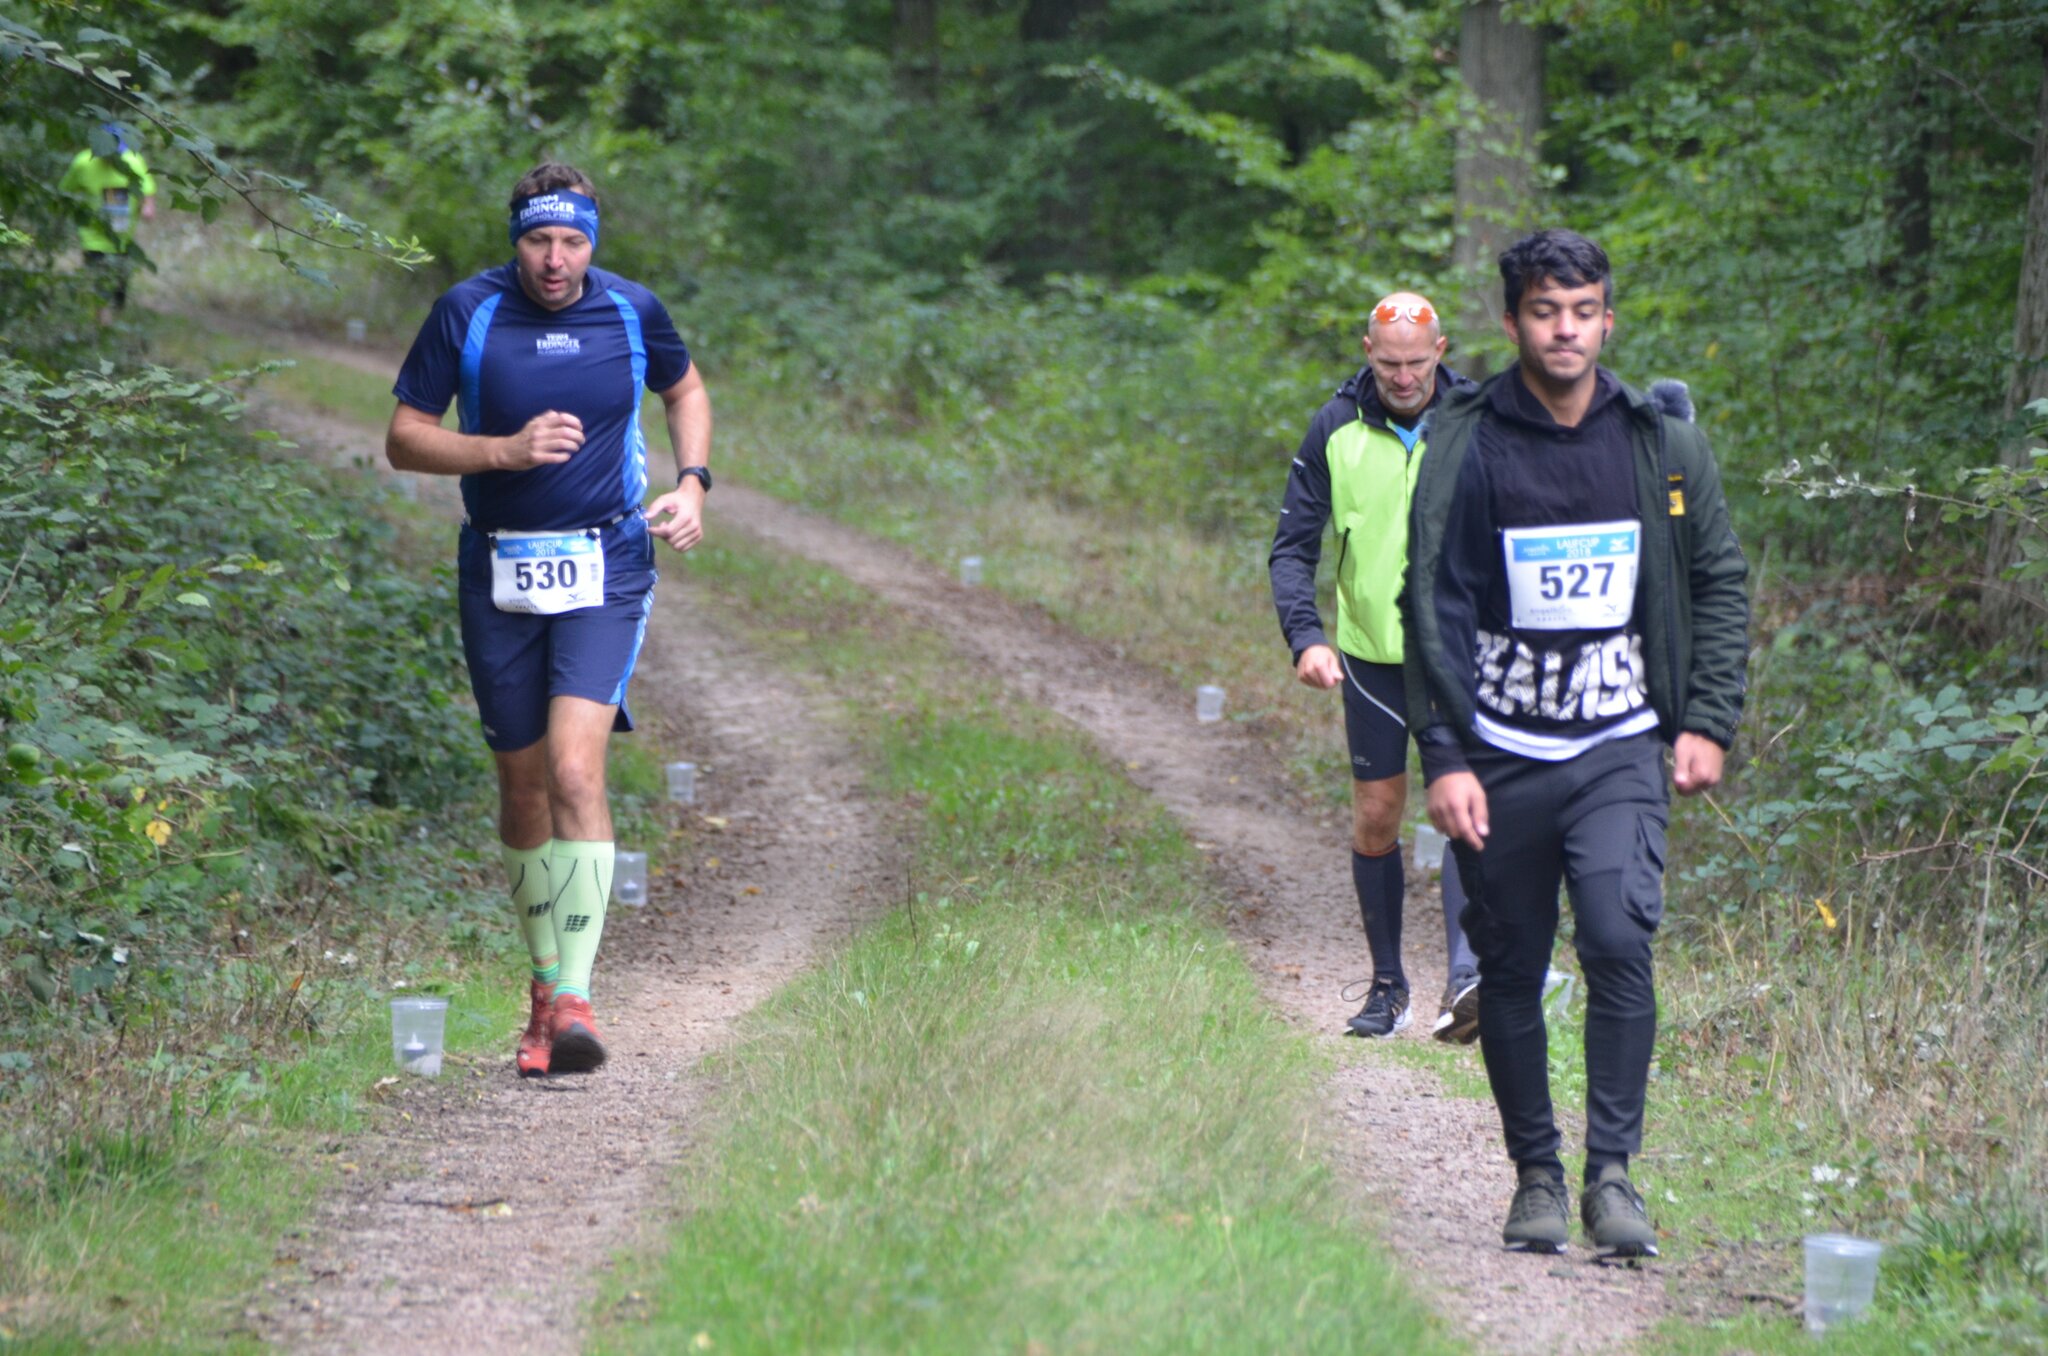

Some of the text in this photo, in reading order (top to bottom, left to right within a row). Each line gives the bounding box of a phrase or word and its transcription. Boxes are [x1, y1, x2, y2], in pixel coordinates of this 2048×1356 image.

[520, 201, 575, 220] ERDINGER
[528, 194, 559, 206] TEAM
[515, 559, 578, 592] 530
[1540, 562, 1615, 601] 527
